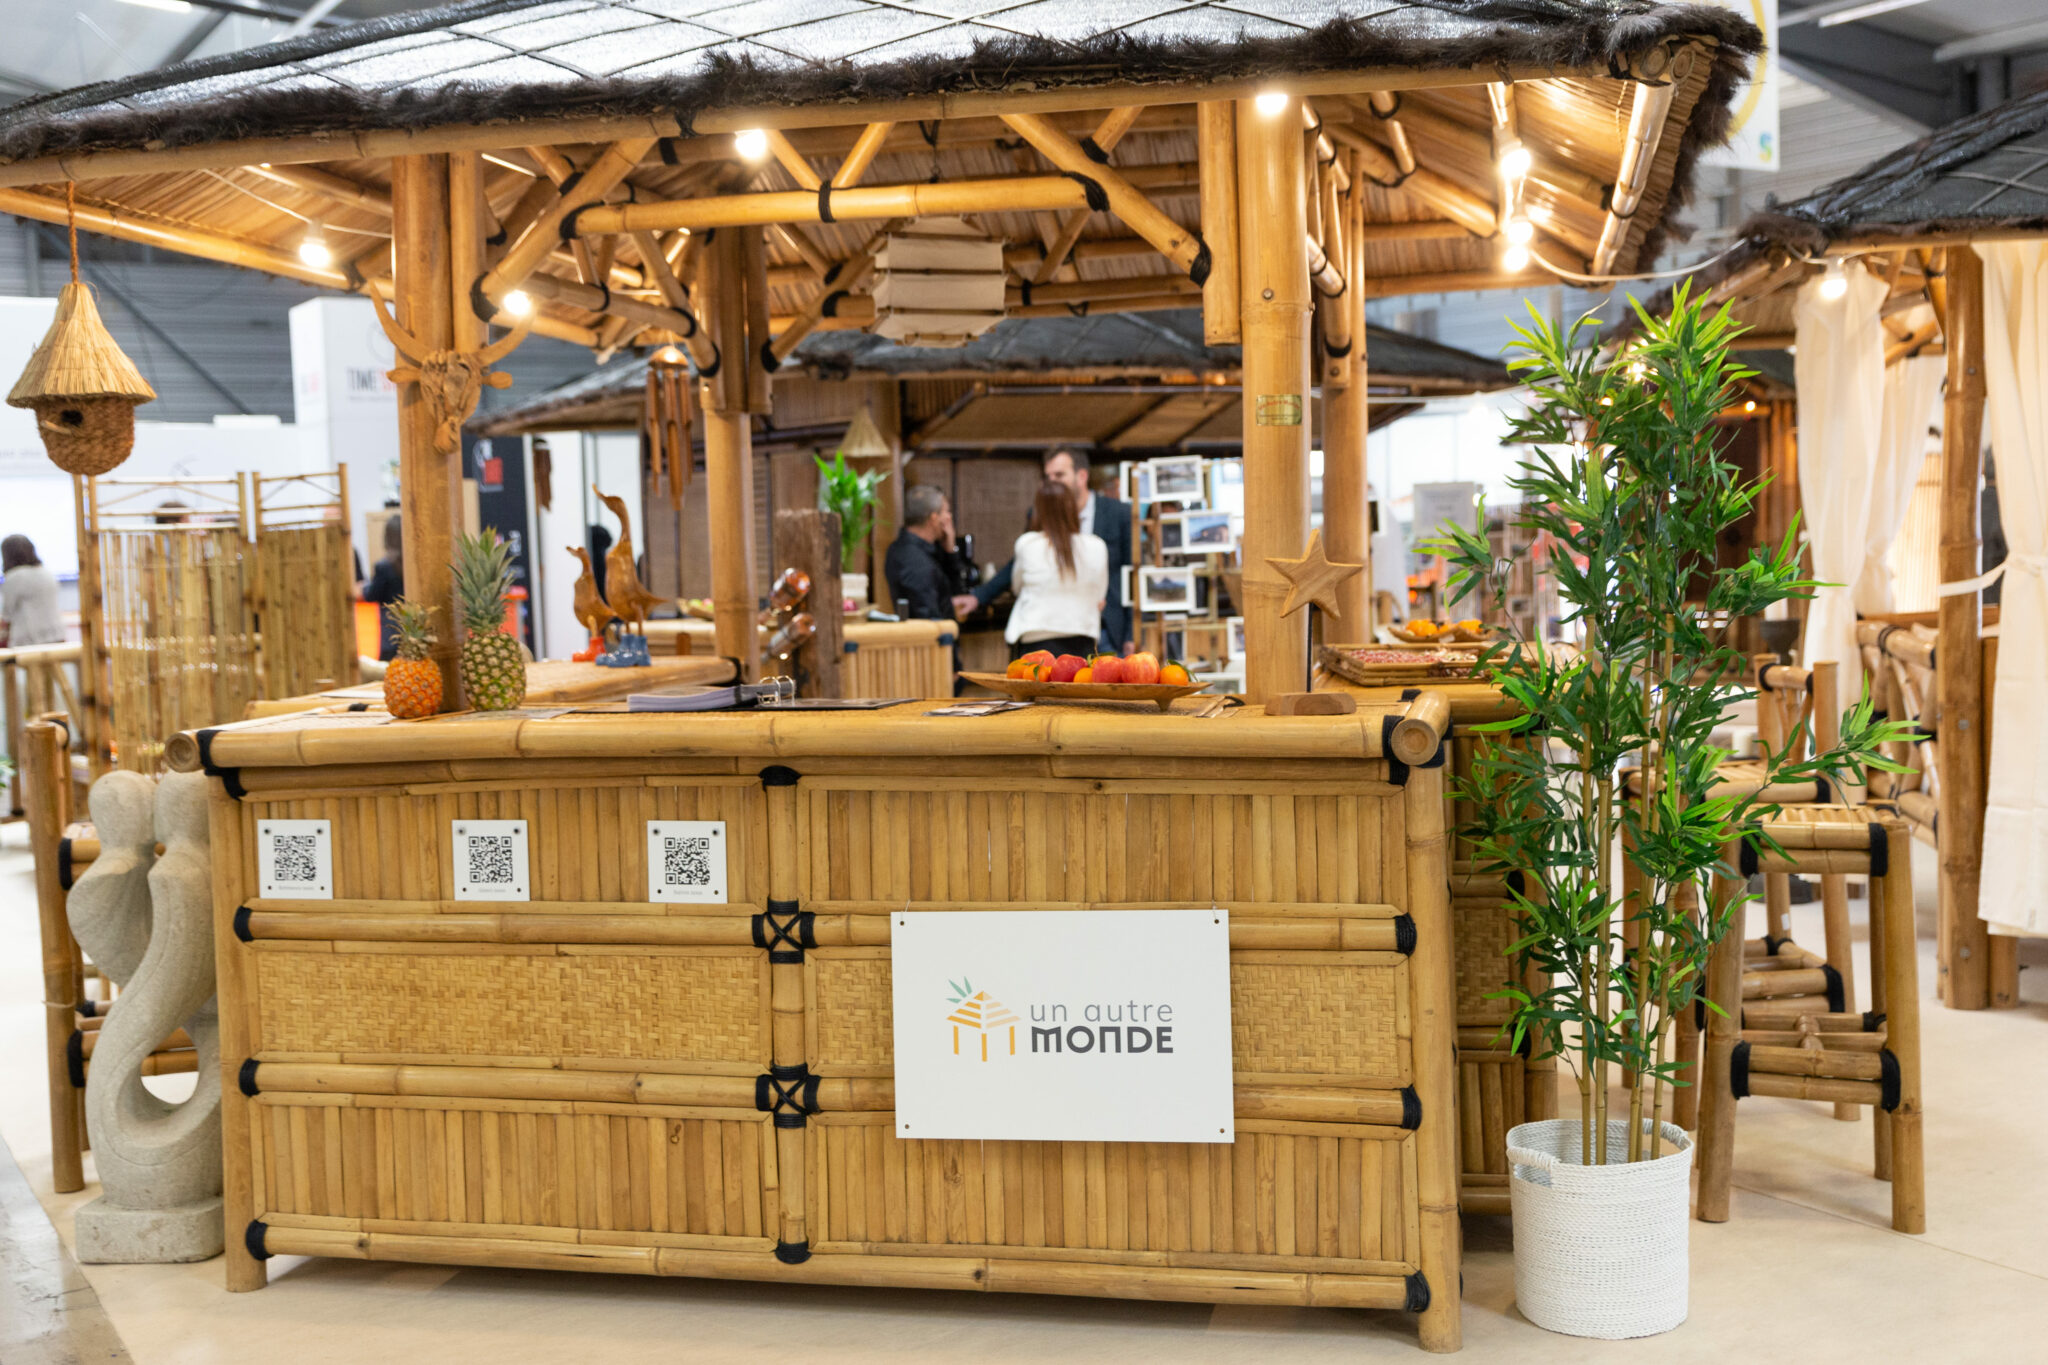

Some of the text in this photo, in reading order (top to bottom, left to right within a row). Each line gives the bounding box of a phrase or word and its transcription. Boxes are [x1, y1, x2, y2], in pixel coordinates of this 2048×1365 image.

[1030, 1000, 1173, 1022] un autre
[1031, 1025, 1174, 1054] MONDE
